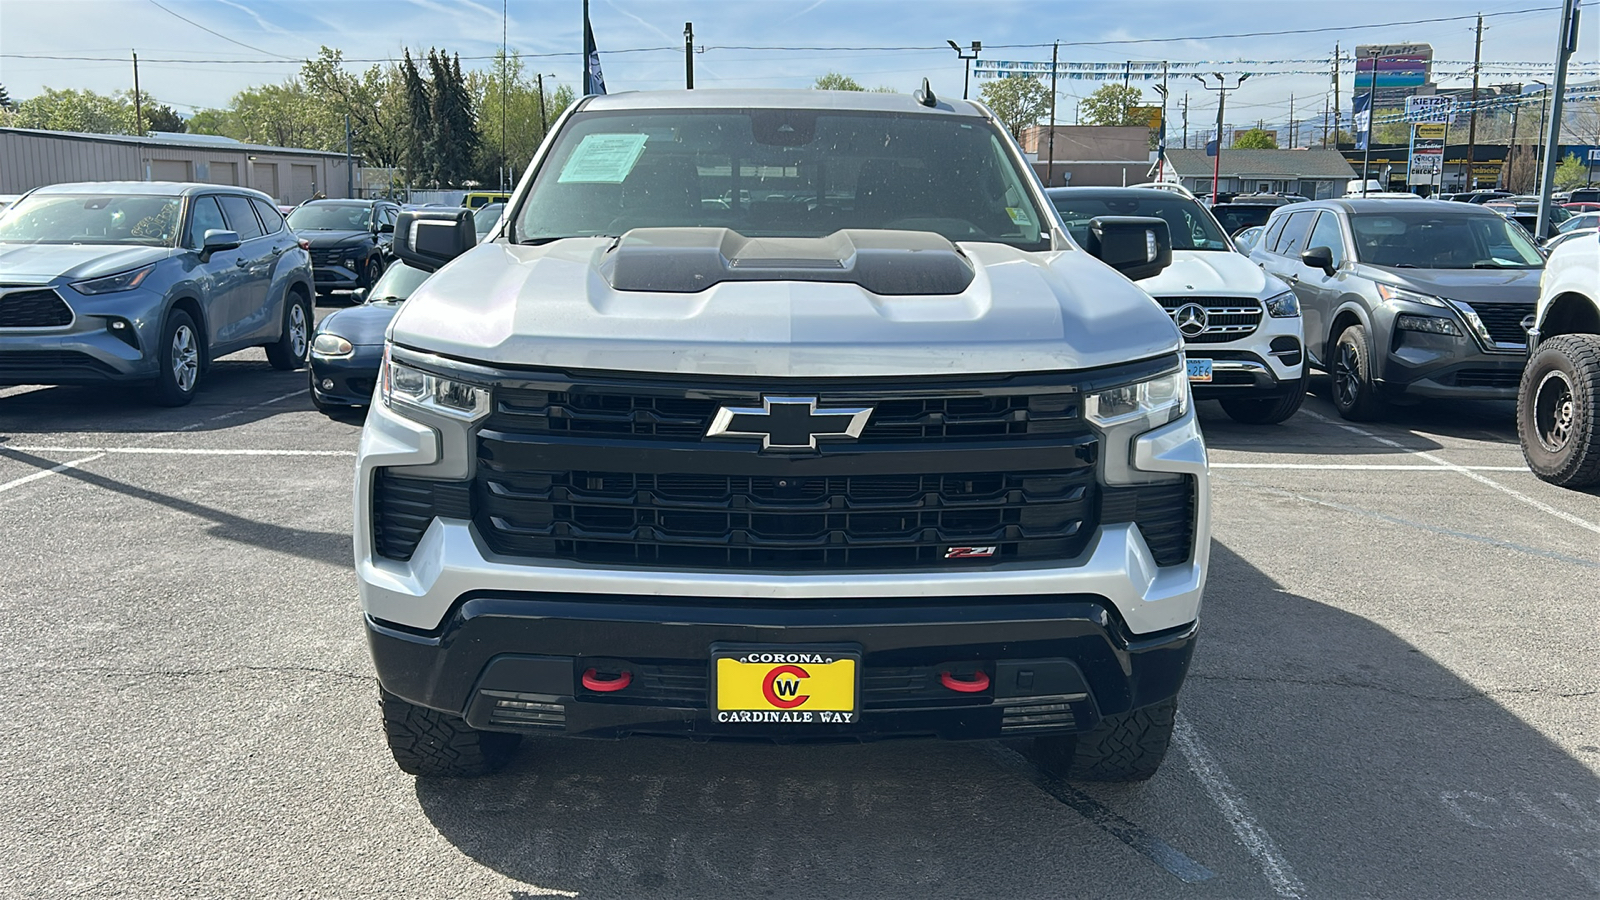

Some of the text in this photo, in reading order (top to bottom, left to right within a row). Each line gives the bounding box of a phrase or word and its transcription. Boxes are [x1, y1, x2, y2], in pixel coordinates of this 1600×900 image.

[944, 546, 997, 558] Z71
[747, 653, 824, 664] CORONA
[717, 711, 854, 723] CARDINALE WAY
